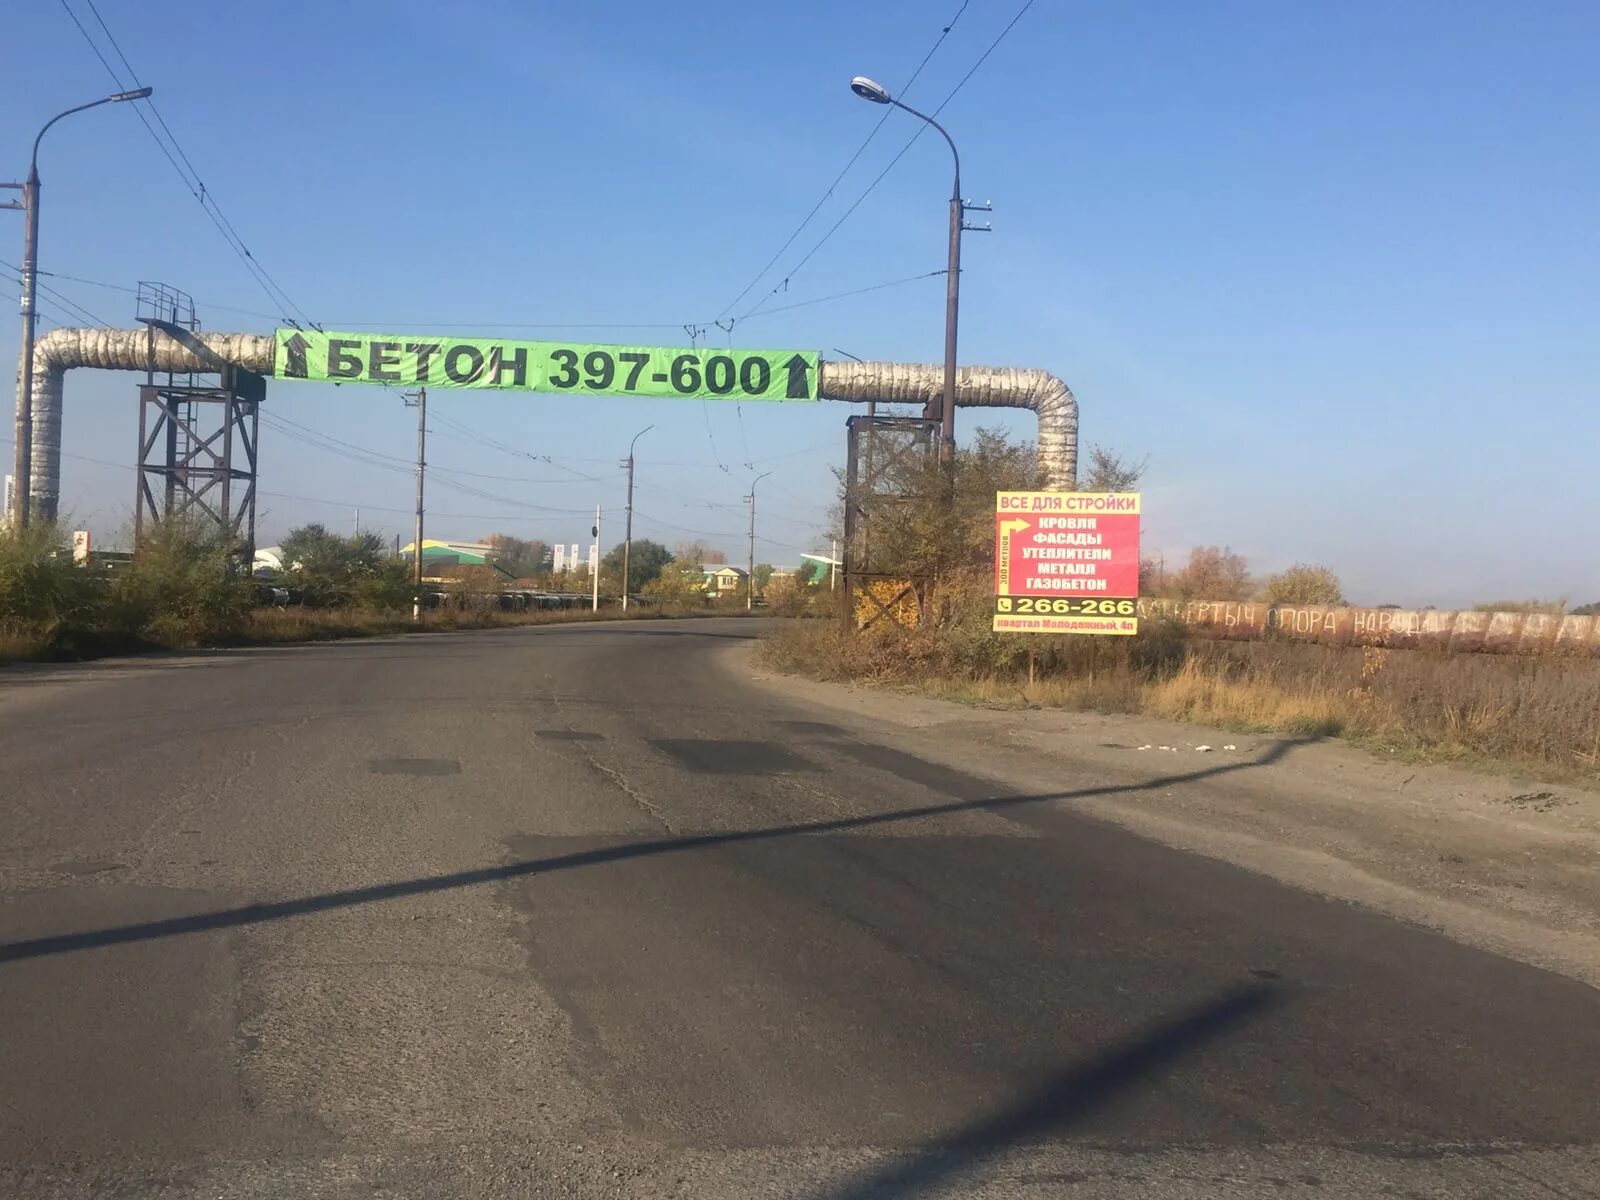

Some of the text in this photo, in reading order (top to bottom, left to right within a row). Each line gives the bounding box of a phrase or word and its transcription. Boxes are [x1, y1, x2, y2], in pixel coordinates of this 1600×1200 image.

[327, 339, 771, 396] БЕТОН 397-600
[1001, 494, 1136, 511] ВСЕ ДЛЯ СТРОЙКИ
[1039, 517, 1097, 530] КРОВЛЯ
[1033, 532, 1102, 546] ФАСАДЫ
[1022, 547, 1112, 561] УТЕПЛИТЕЛИ
[1037, 562, 1096, 575] МЕТАЛЛ
[1026, 578, 1107, 591] ГАЗОБЕТОН
[1016, 598, 1135, 615] 266-266
[997, 619, 1040, 629] квартал
[1267, 608, 1337, 634] ОПОРА
